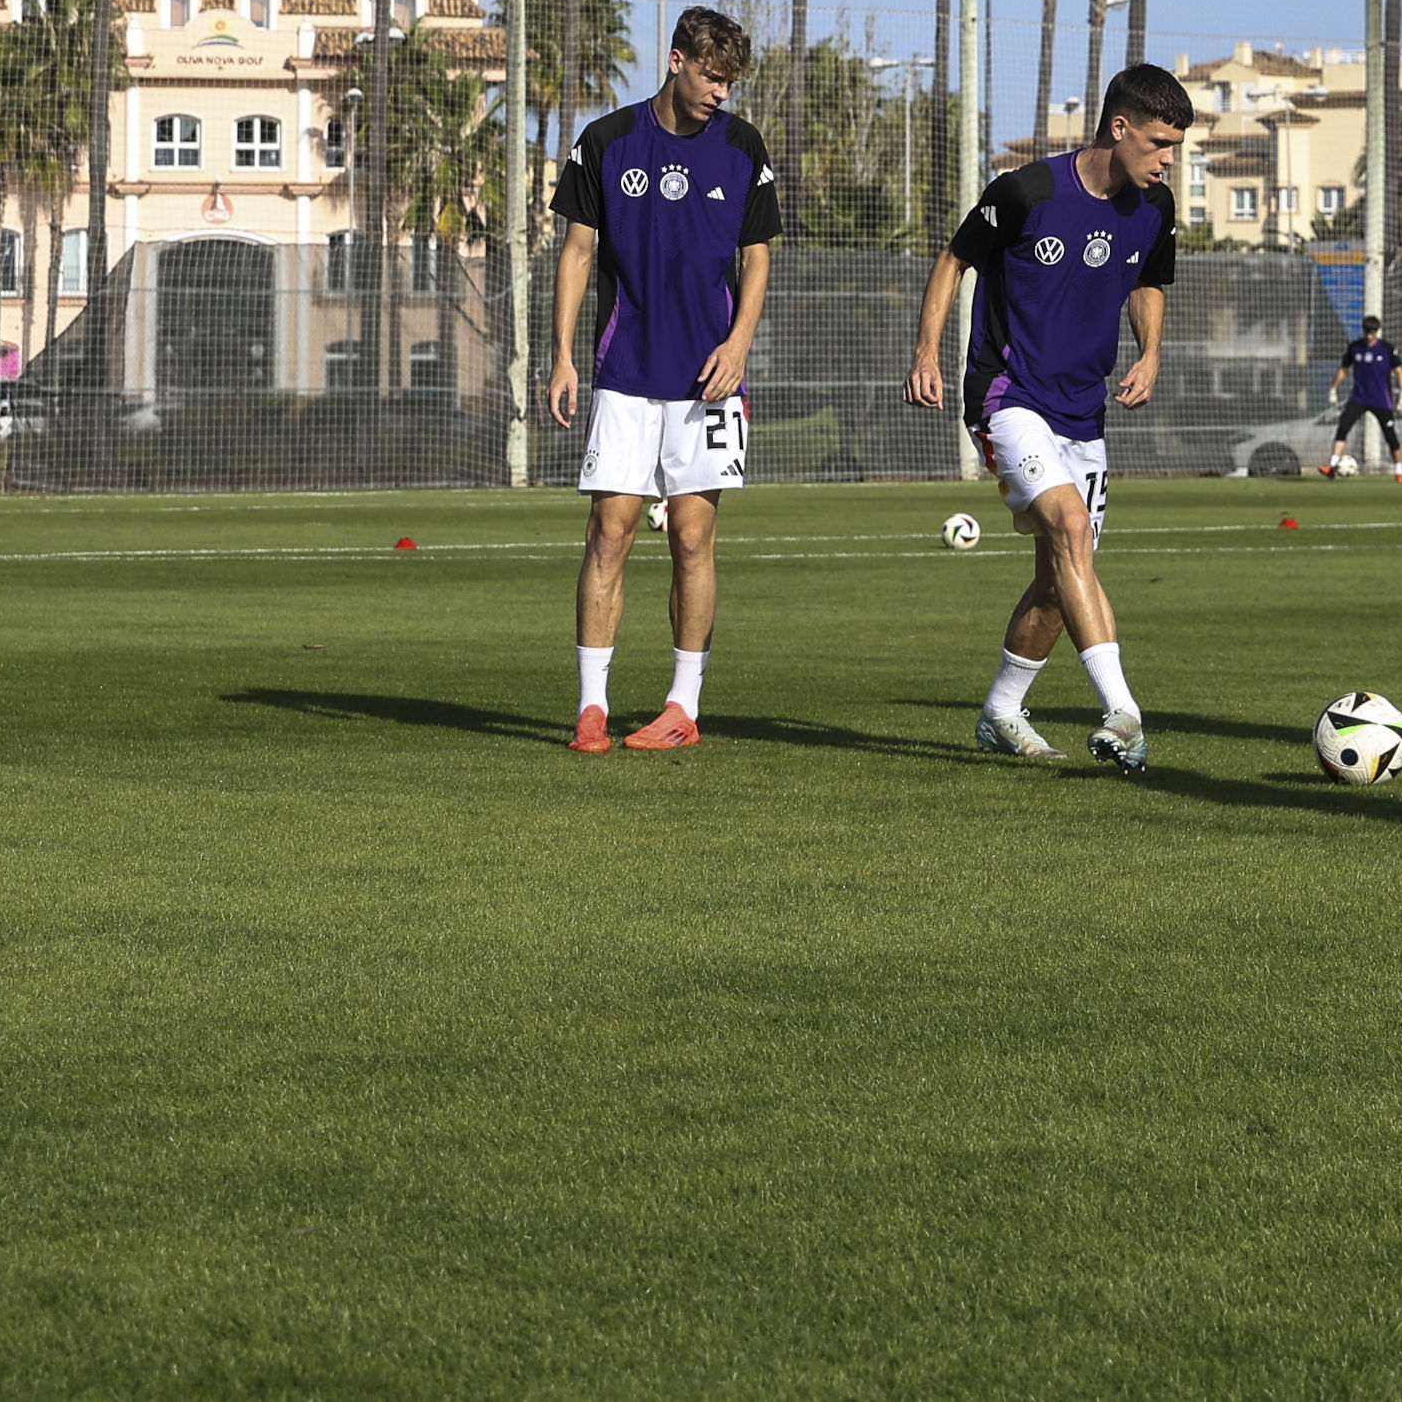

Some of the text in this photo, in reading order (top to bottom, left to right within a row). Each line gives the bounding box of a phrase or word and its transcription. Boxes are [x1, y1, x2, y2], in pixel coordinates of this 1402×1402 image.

[176, 55, 204, 65] OLIVA
[206, 56, 235, 65] NOVA
[620, 168, 649, 197] VW
[1034, 236, 1065, 265] VW
[705, 409, 744, 450] 21
